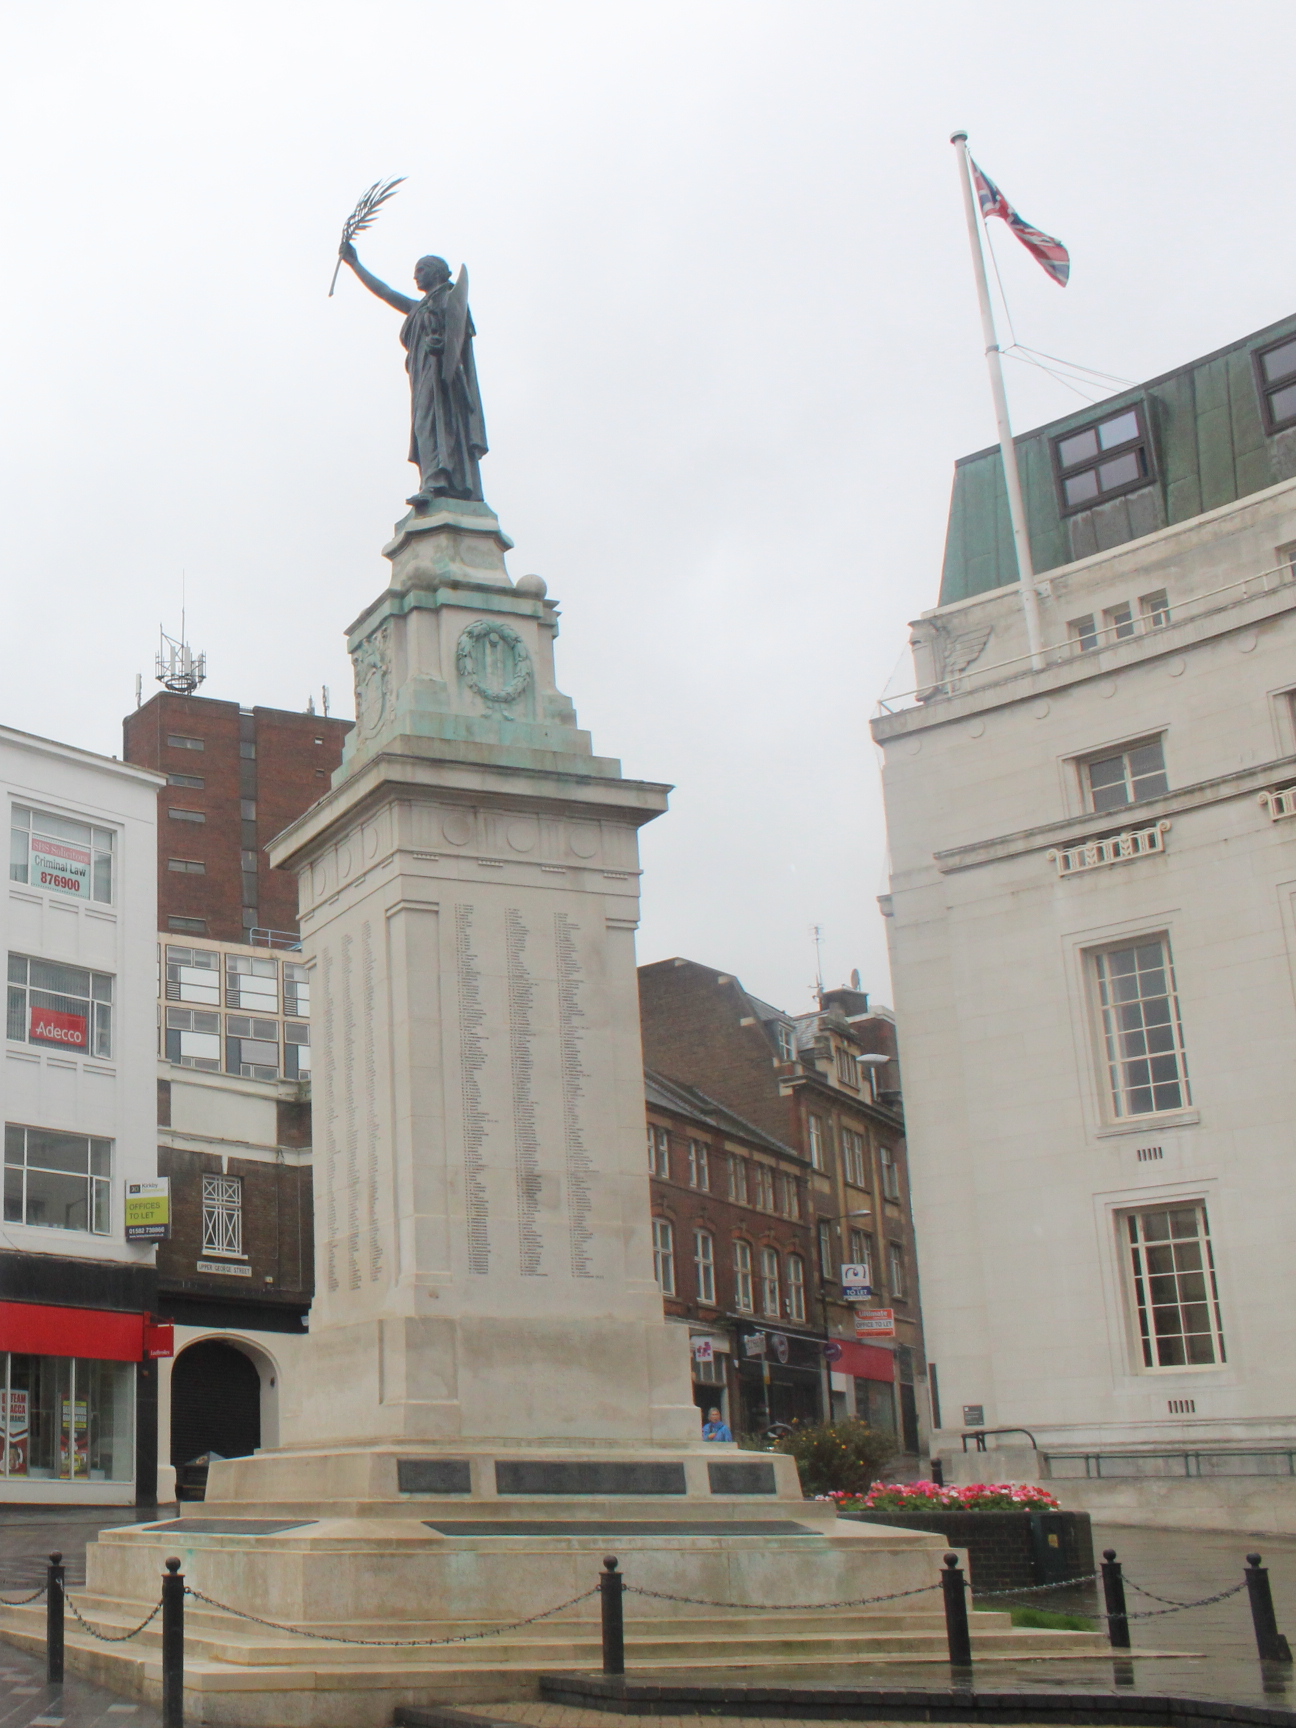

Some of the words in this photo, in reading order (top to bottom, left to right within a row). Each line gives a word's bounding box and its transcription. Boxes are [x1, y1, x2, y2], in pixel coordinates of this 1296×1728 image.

[33, 841, 50, 854] SBS
[51, 846, 89, 864] Solicitors
[34, 854, 68, 873] Criminal
[69, 863, 87, 877] Law
[40, 871, 80, 892] 876900
[35, 1021, 82, 1043] Adecco
[129, 1202, 161, 1210] OFFICES
[198, 1262, 213, 1271] UPPER
[214, 1264, 232, 1273] GEORGE
[233, 1266, 250, 1275] STREET
